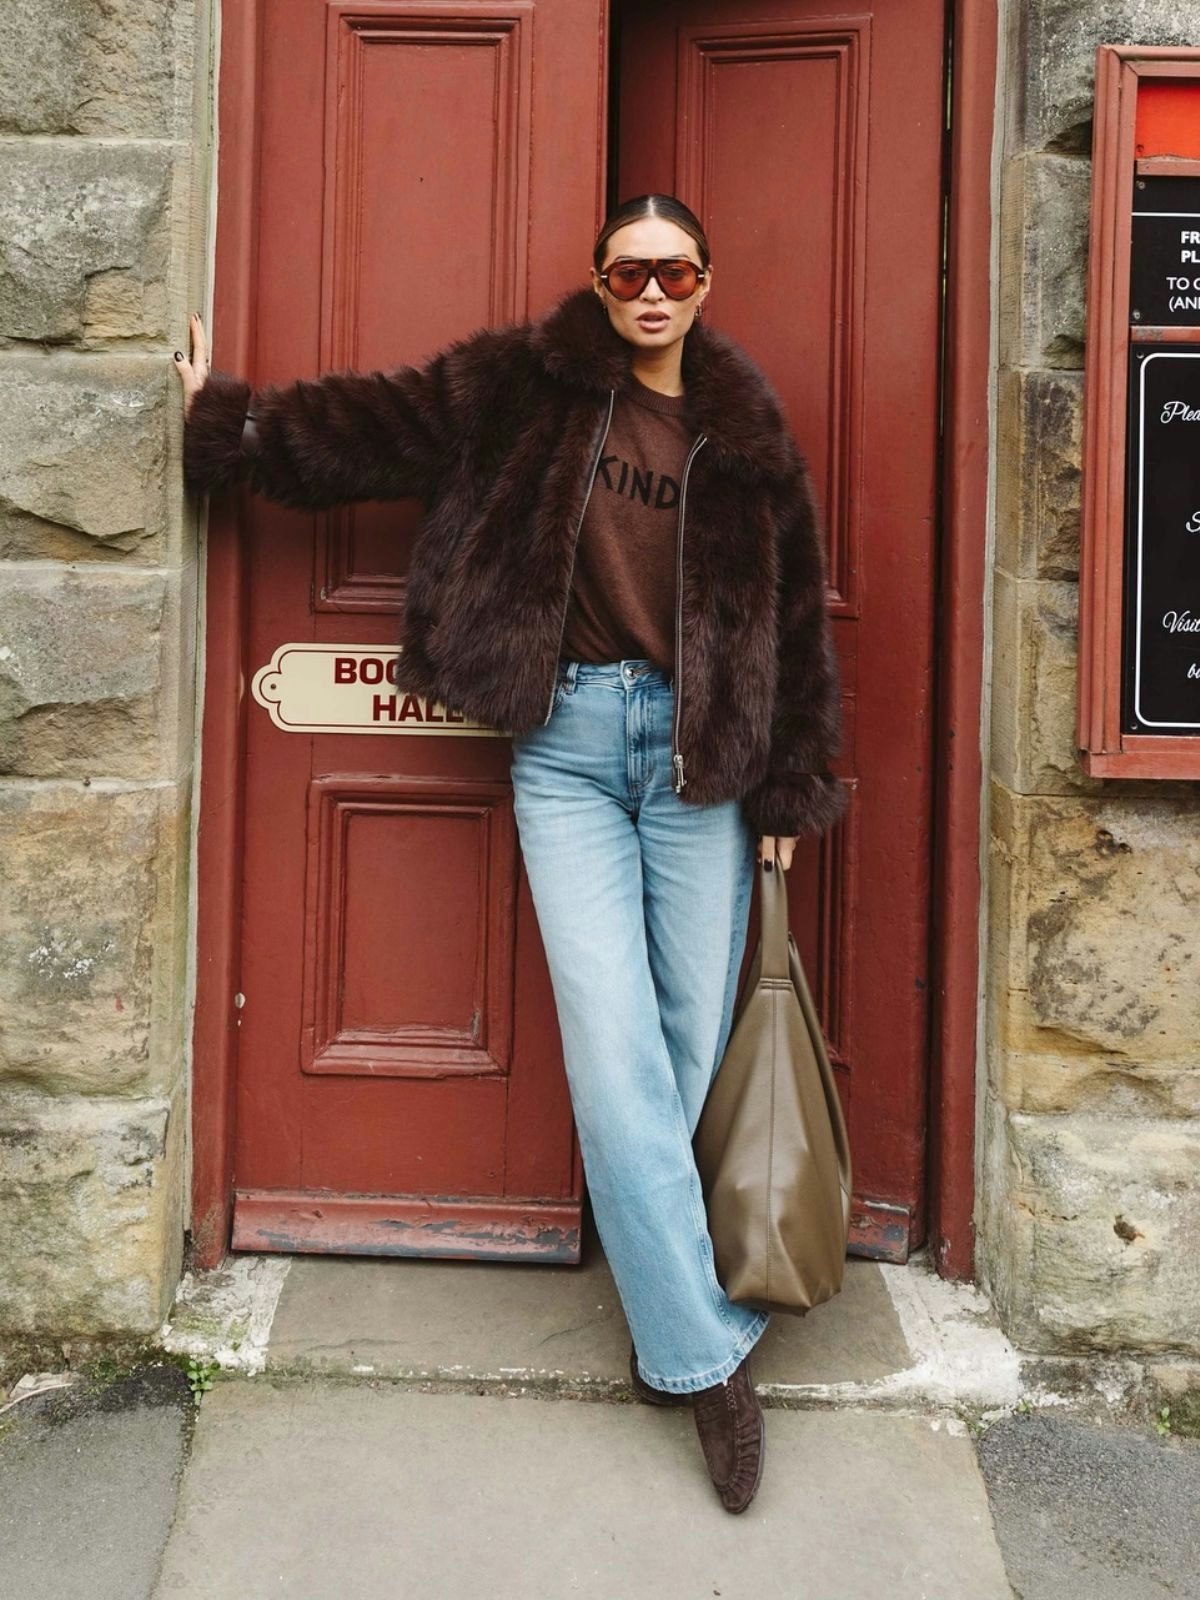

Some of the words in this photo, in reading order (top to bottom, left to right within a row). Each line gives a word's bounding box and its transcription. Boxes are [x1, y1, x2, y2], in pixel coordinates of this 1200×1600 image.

[1165, 276, 1190, 291] TO
[1168, 295, 1200, 313] (AN
[594, 455, 680, 510] KIND
